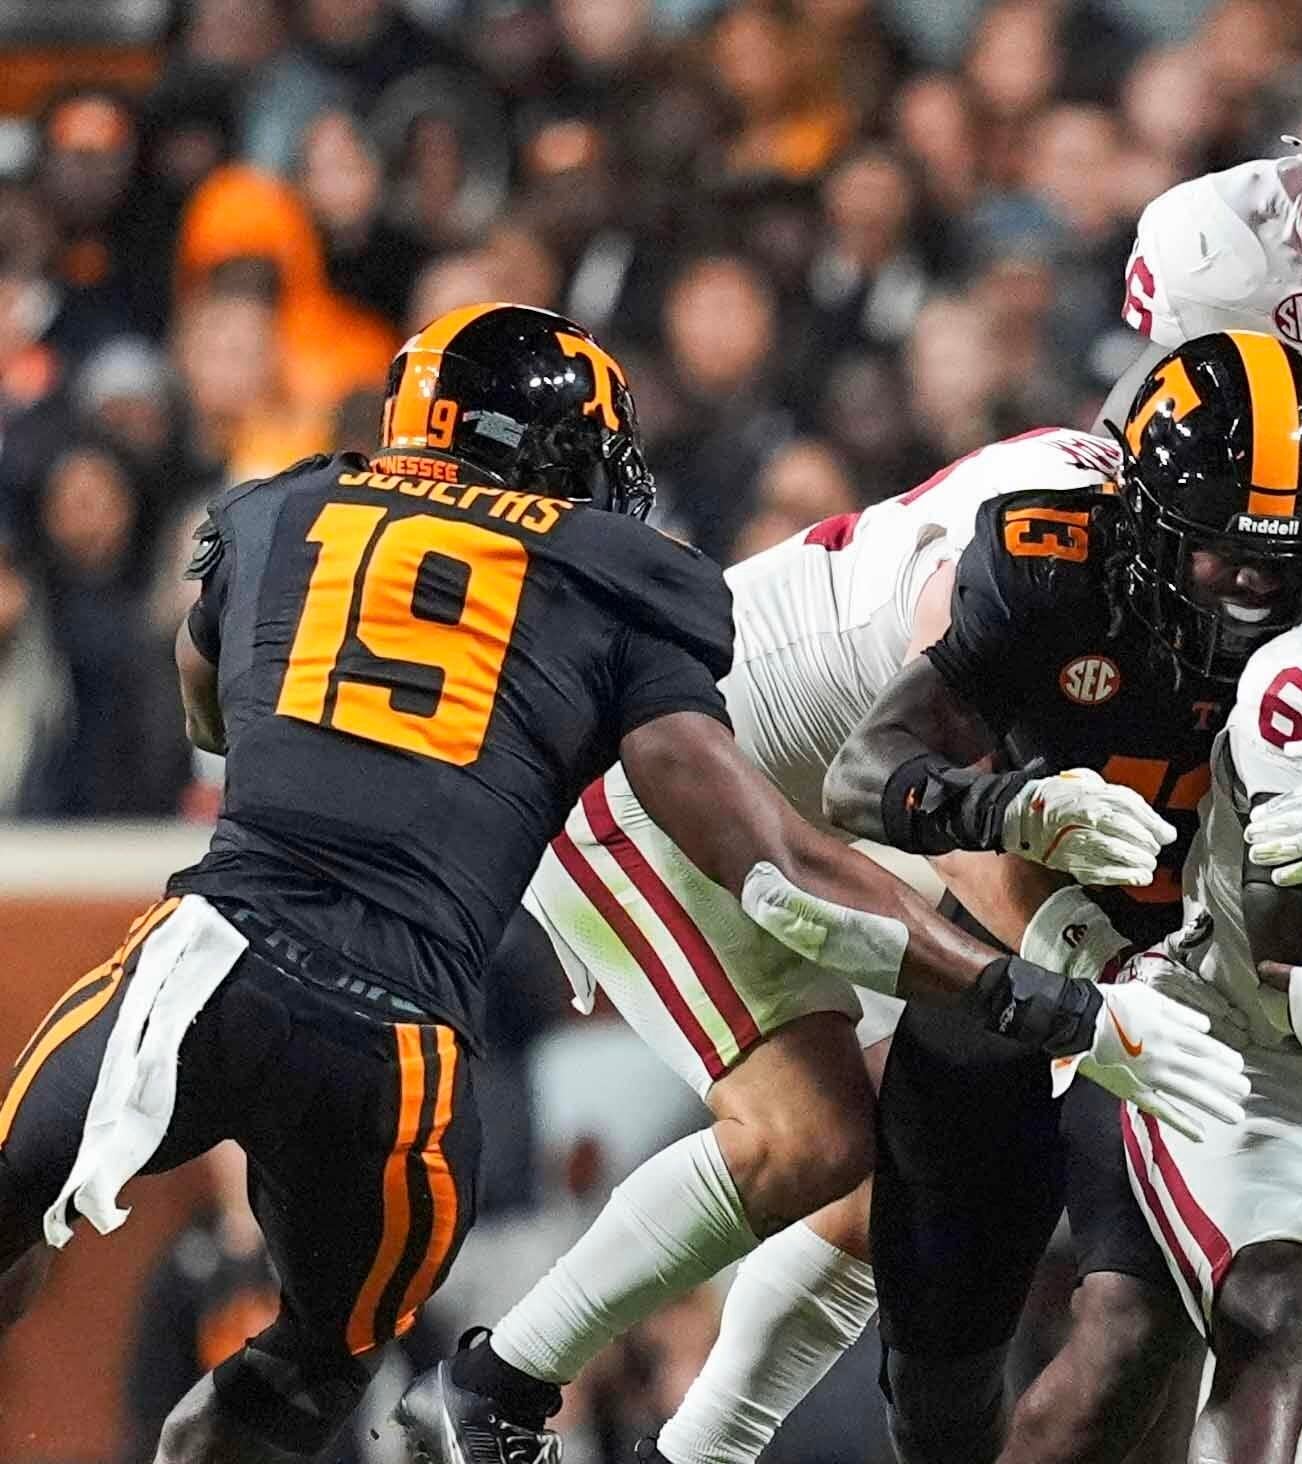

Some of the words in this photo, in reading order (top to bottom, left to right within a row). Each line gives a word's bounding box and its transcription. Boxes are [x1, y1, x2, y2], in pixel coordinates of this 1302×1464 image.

[1004, 507, 1090, 563] 13
[1237, 516, 1300, 536] Riddell
[275, 503, 529, 767] 19
[1065, 659, 1116, 701] SEC
